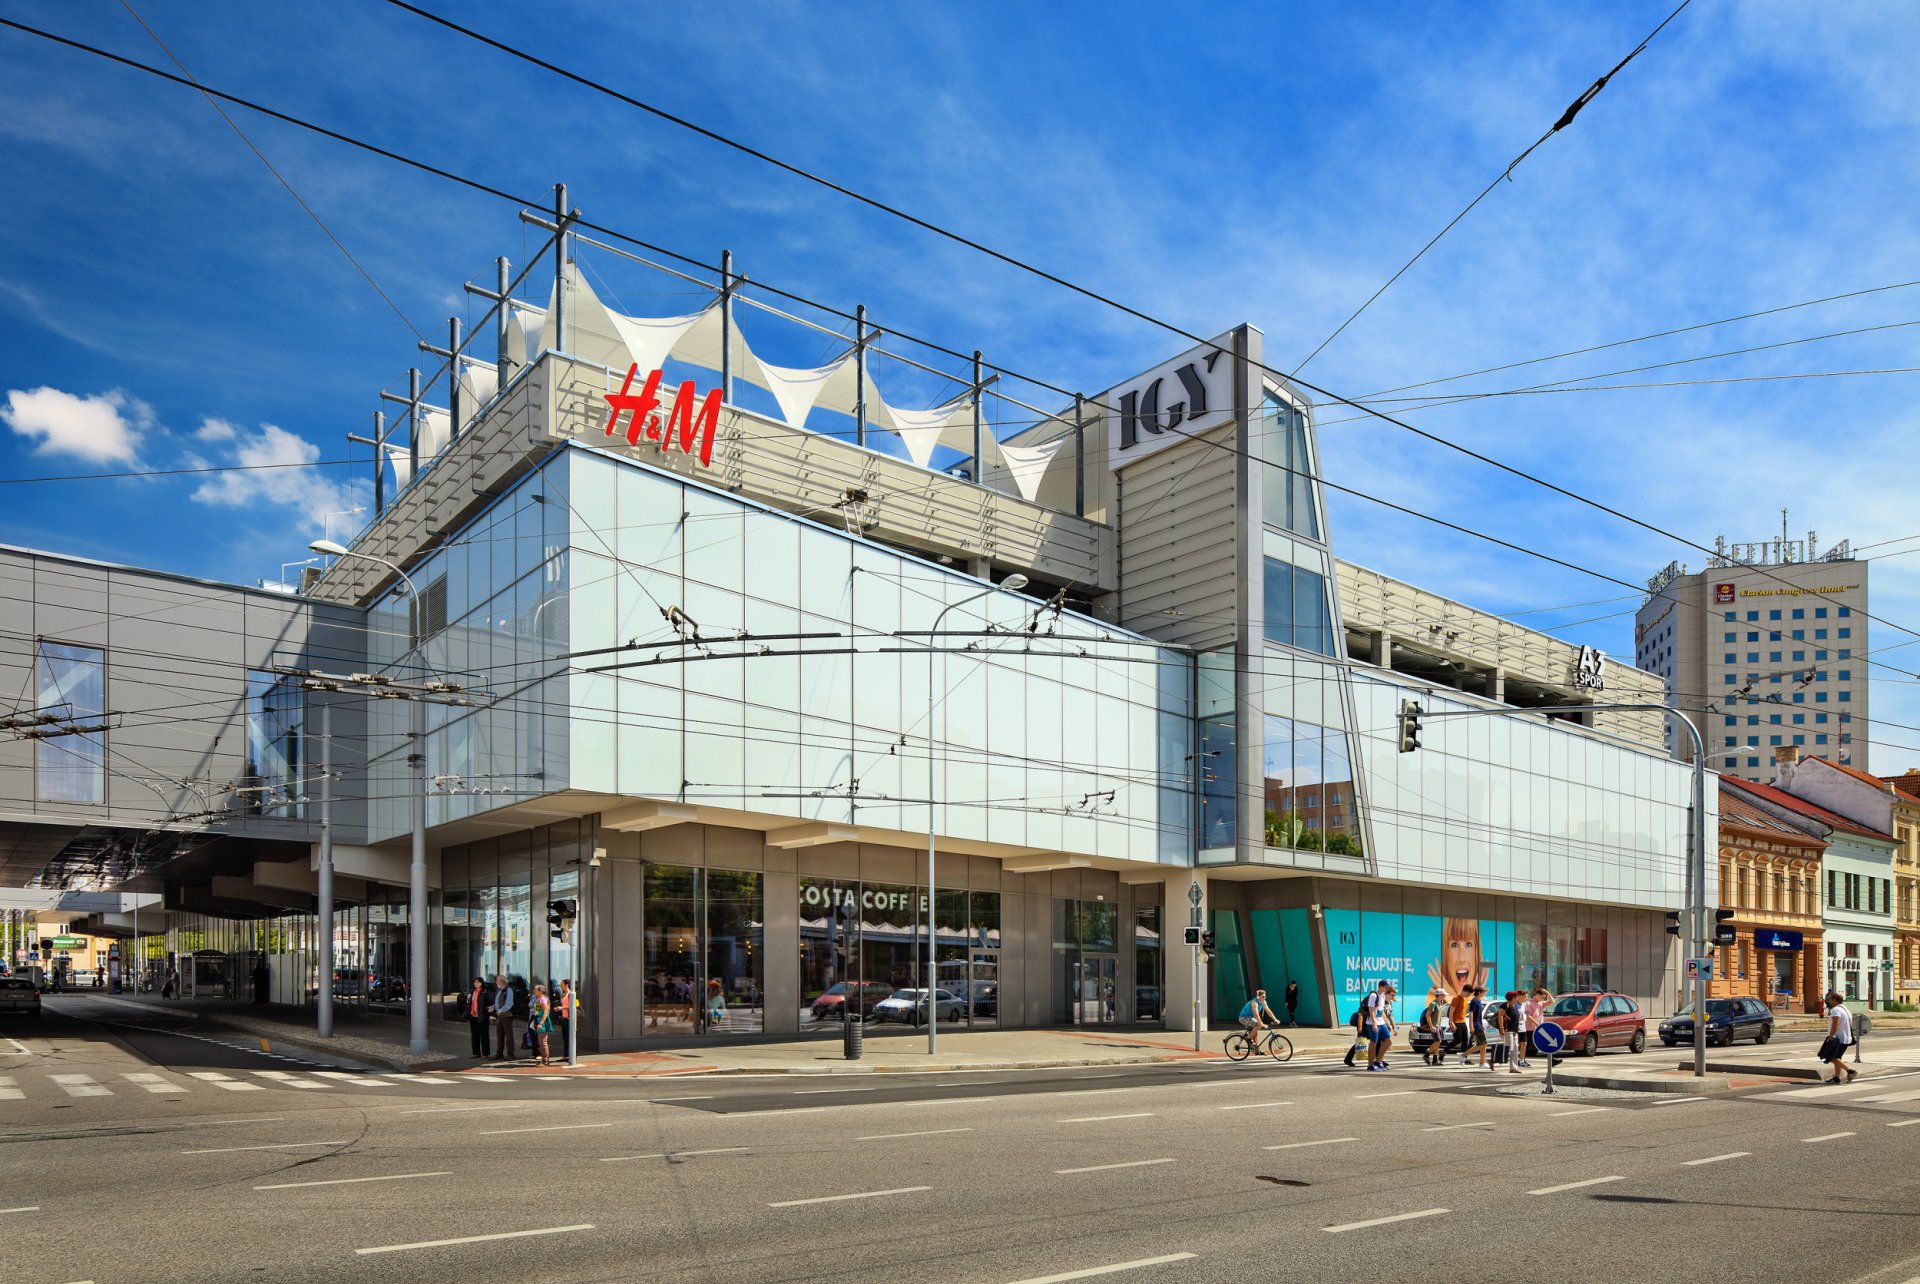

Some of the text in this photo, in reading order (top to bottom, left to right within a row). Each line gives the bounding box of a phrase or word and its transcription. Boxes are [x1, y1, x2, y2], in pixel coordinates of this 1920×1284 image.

[1118, 349, 1223, 450] IGY
[604, 362, 723, 467] H&M
[1340, 931, 1357, 944] IGY
[1346, 956, 1414, 974] NAKUPUJTE,
[1689, 963, 1697, 972] P
